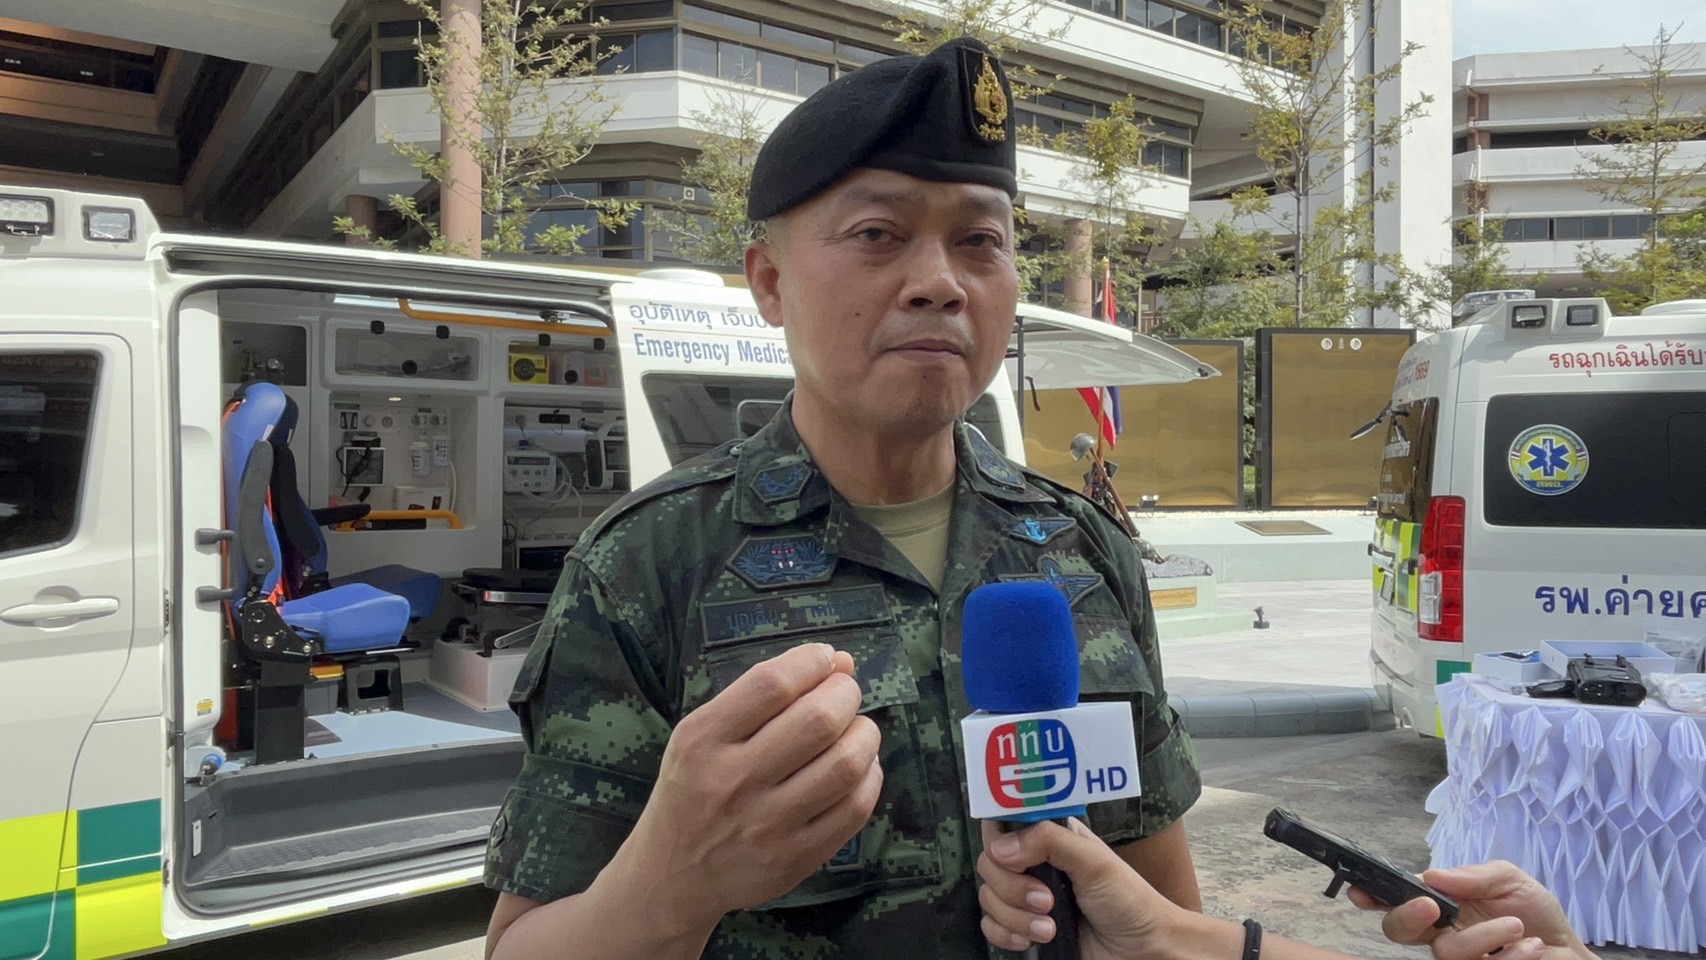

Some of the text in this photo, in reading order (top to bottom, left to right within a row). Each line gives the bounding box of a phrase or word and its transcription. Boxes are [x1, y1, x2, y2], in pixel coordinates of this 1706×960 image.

[629, 302, 713, 330] อุบัติเหตุ
[634, 333, 729, 366] Emergency
[1549, 340, 1706, 378] รถฉุกเฉินได้รับ
[1086, 766, 1128, 794] HD
